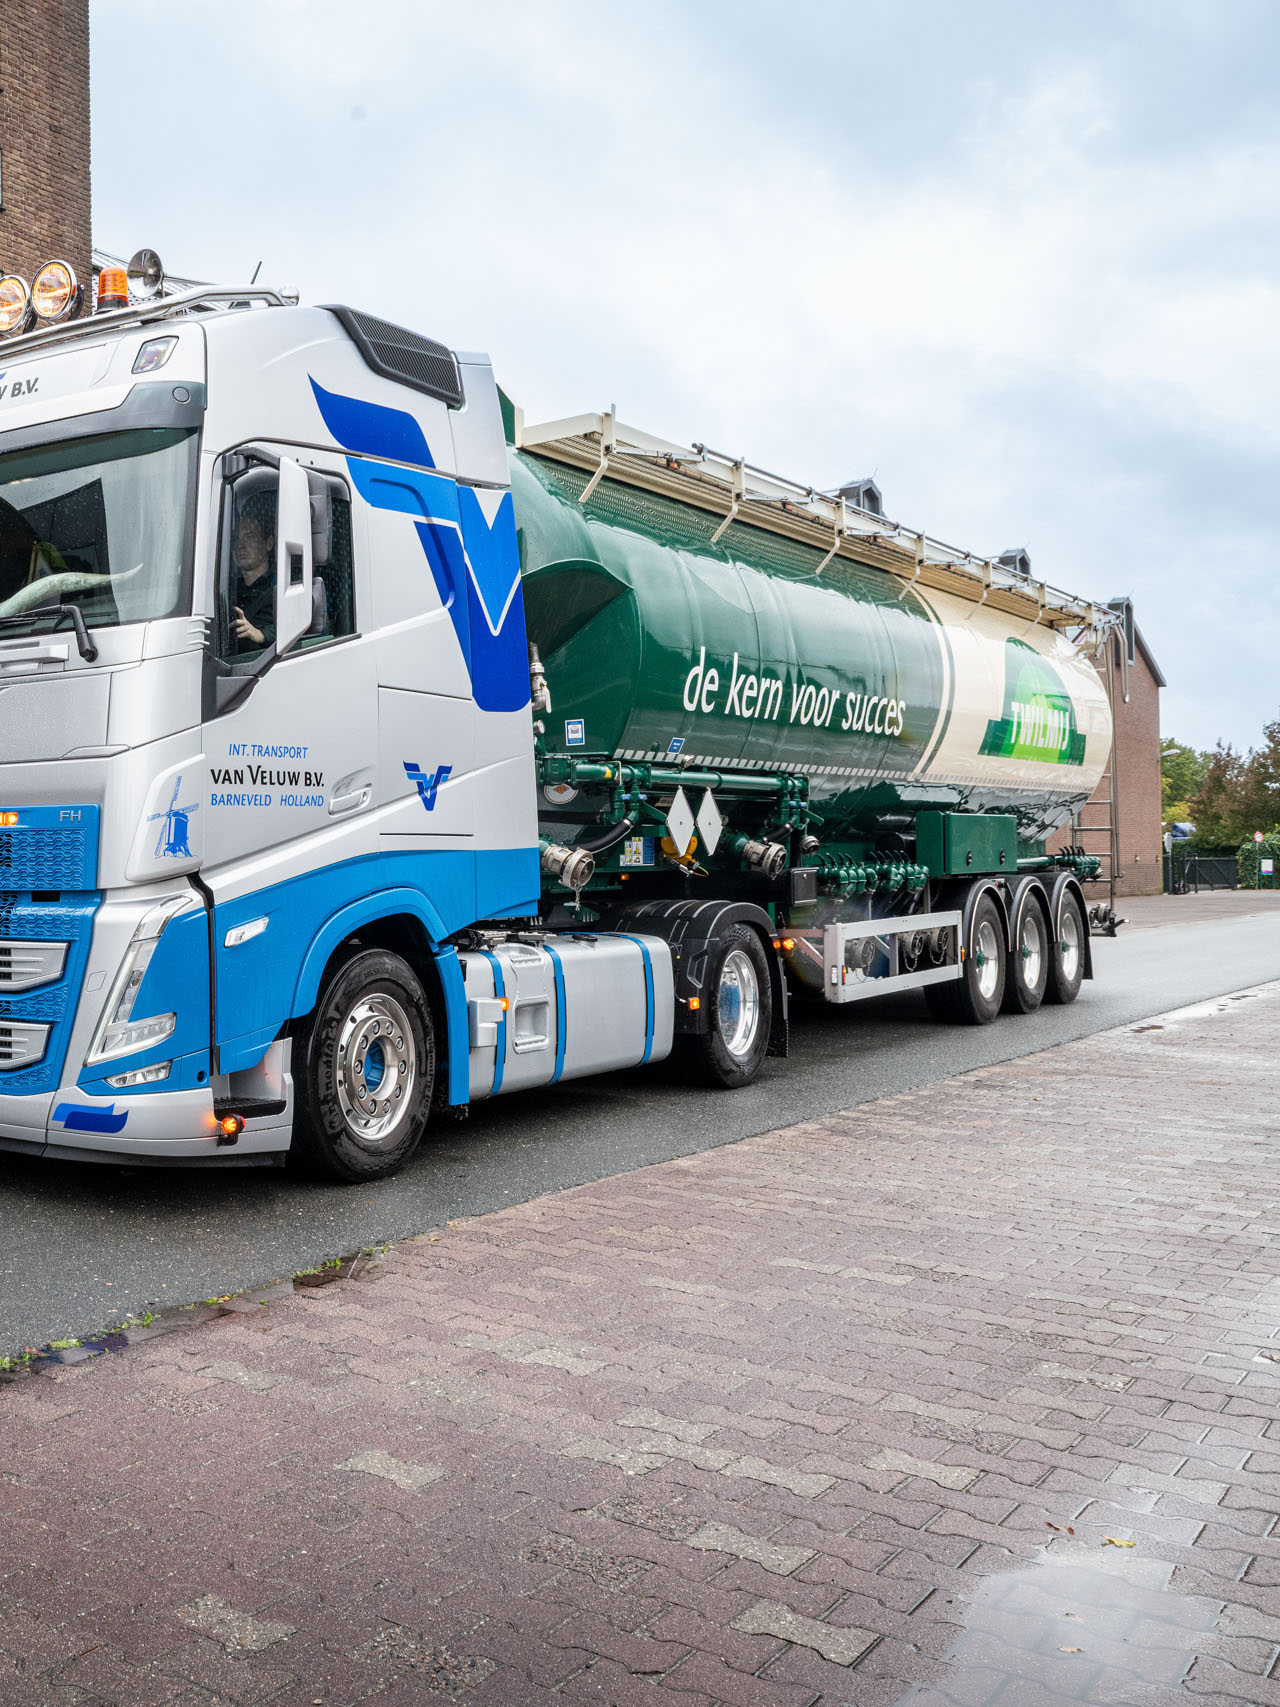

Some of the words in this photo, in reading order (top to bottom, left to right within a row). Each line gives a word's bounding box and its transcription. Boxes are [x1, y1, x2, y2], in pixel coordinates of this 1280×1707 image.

[10, 377, 40, 398] B.V.
[683, 646, 719, 713] de
[724, 652, 783, 720] kern
[789, 683, 840, 727] voor
[841, 692, 906, 737] succes
[251, 744, 309, 759] TRANSPORT
[210, 769, 244, 785] VAN
[247, 764, 301, 787] VELUW
[304, 772, 325, 788] B.V.
[210, 793, 272, 807] BARNEVELD
[280, 795, 324, 807] HOLLAND
[59, 810, 82, 823] FH
